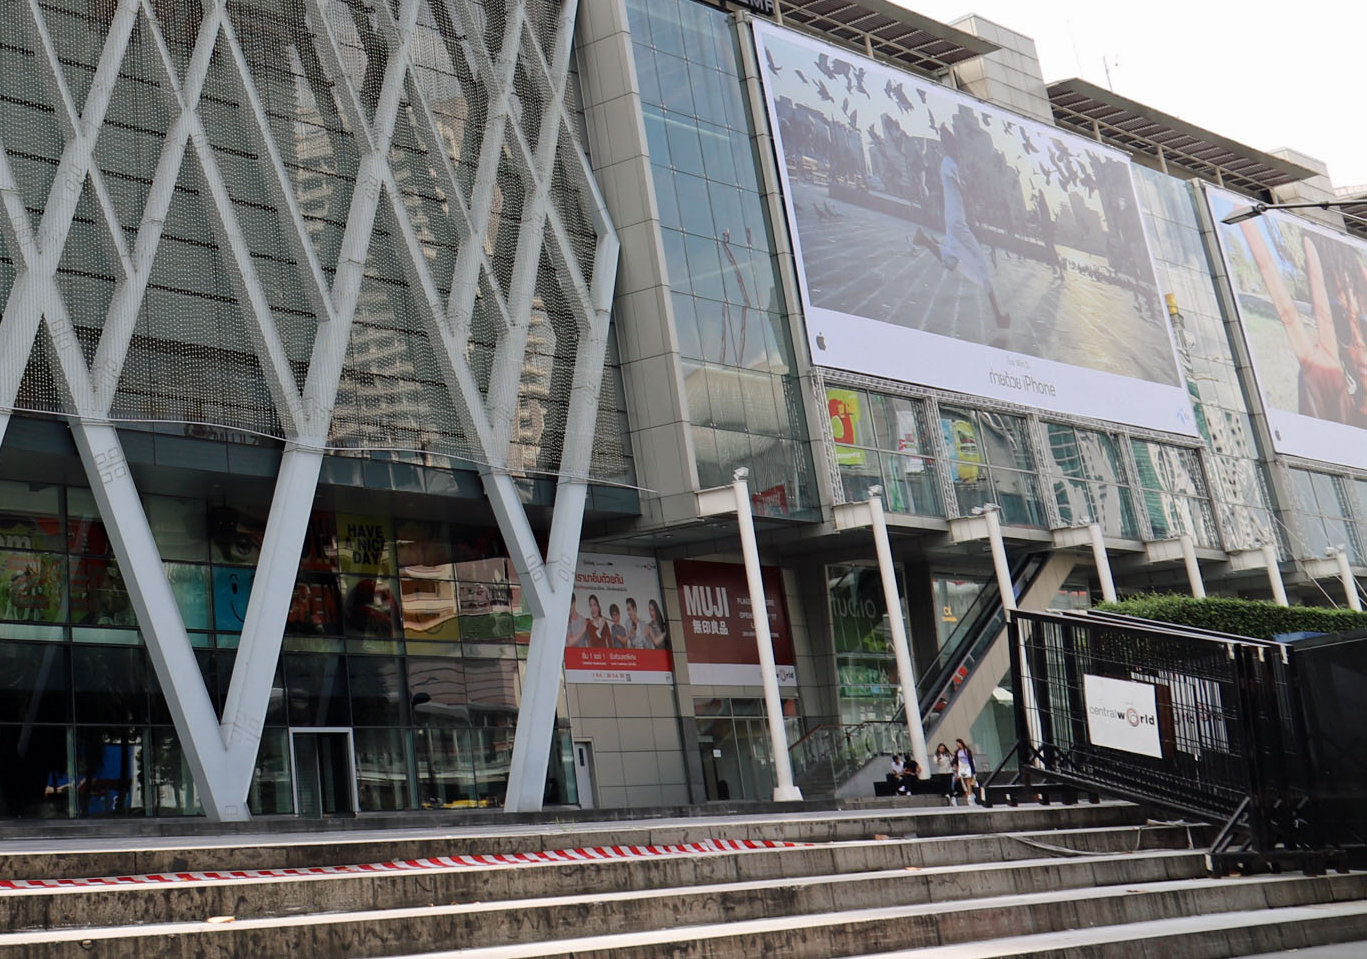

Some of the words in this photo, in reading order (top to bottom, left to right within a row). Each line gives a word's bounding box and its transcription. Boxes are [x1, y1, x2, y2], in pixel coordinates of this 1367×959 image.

[1024, 375, 1057, 397] iPhone
[347, 523, 384, 539] HAVE
[353, 551, 381, 565] DAY
[683, 585, 730, 617] MUJI
[693, 619, 729, 635] 無印良品
